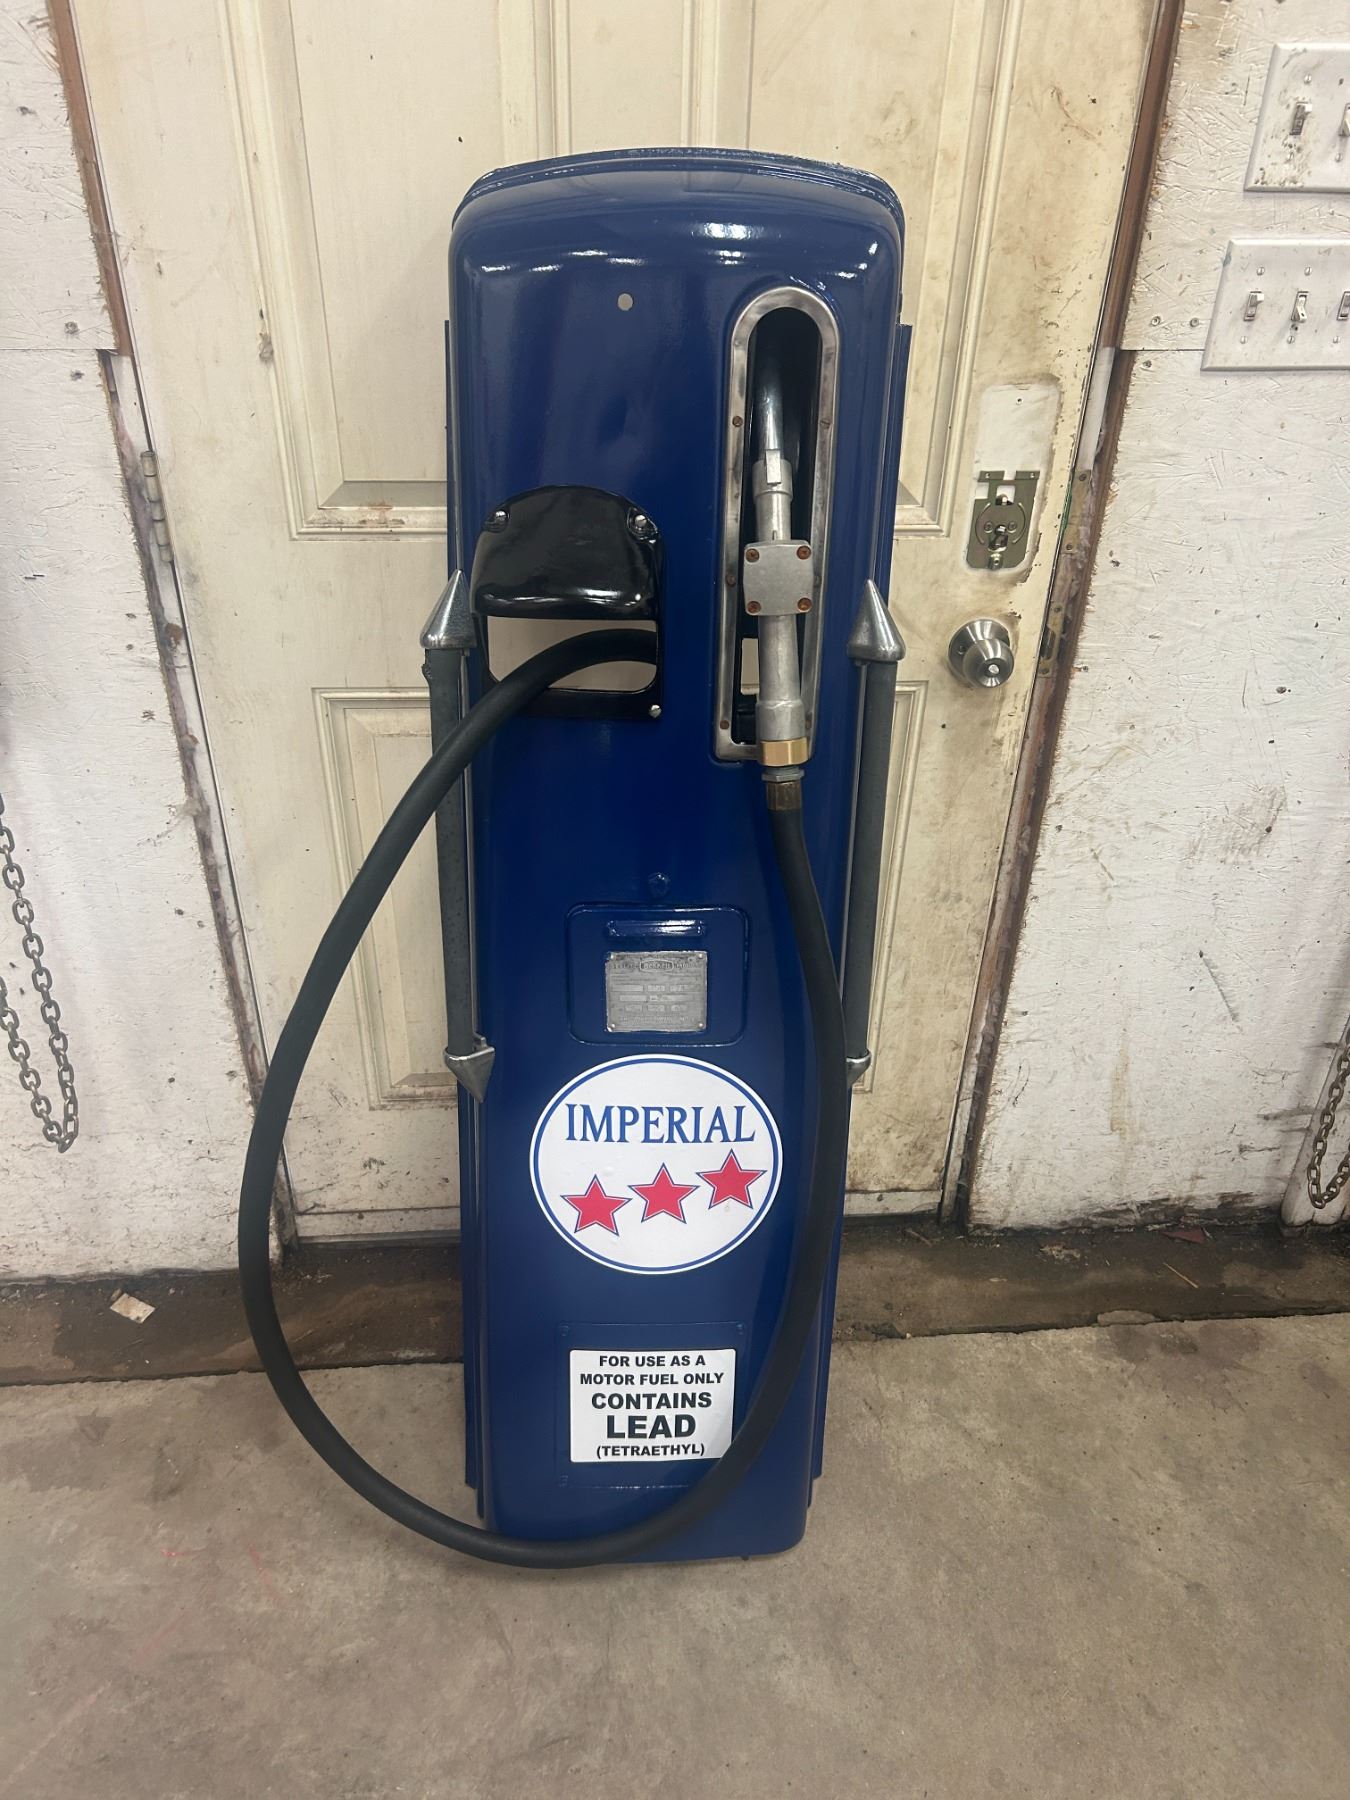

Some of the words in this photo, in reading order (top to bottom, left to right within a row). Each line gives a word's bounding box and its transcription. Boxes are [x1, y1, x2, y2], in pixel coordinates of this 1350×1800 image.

[565, 1103, 756, 1144] IMPERIAL
[599, 1355, 630, 1367] FOR
[635, 1355, 666, 1367] USE
[670, 1355, 690, 1366] AS
[695, 1355, 706, 1366] A
[580, 1373, 635, 1385] MOTOR
[639, 1374, 679, 1385] FUEL
[683, 1372, 724, 1385] ONLY
[591, 1392, 712, 1410] CONTAINS
[607, 1414, 696, 1439] LEAD
[596, 1443, 705, 1459] (TETRAETHYL)
